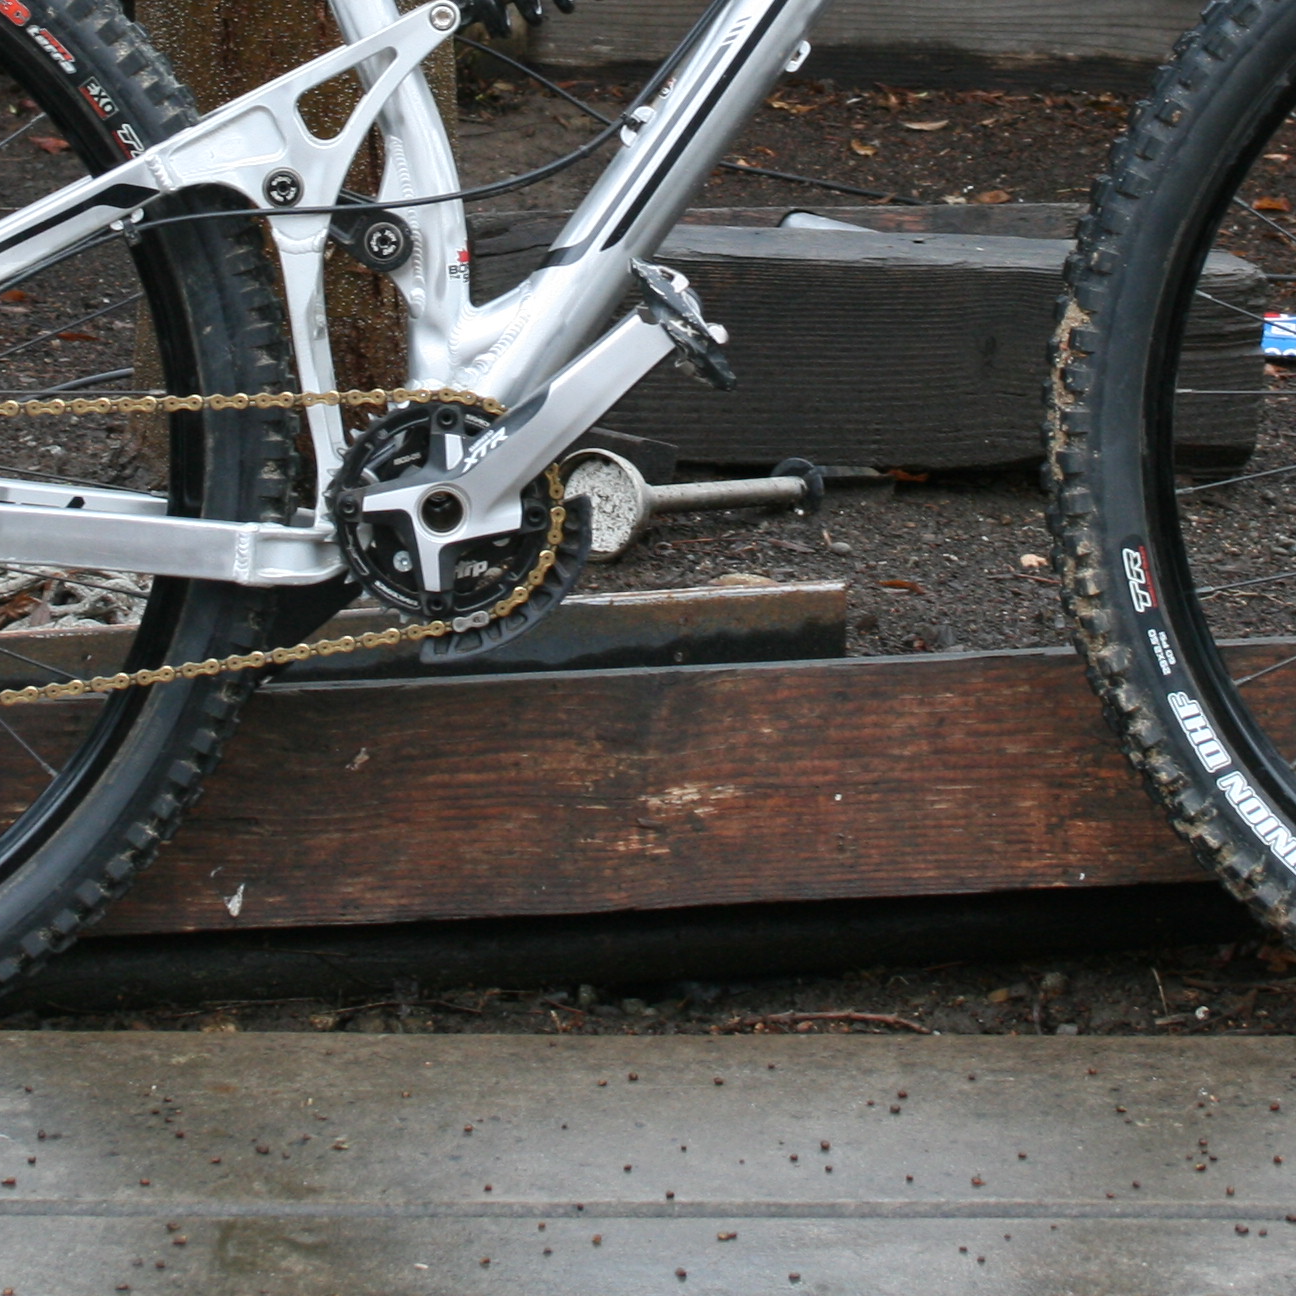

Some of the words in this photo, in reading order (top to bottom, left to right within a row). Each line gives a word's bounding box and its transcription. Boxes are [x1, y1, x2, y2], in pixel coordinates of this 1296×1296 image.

[461, 426, 509, 473] XTR
[1122, 548, 1152, 613] TR
[1167, 691, 1231, 773] DHF
